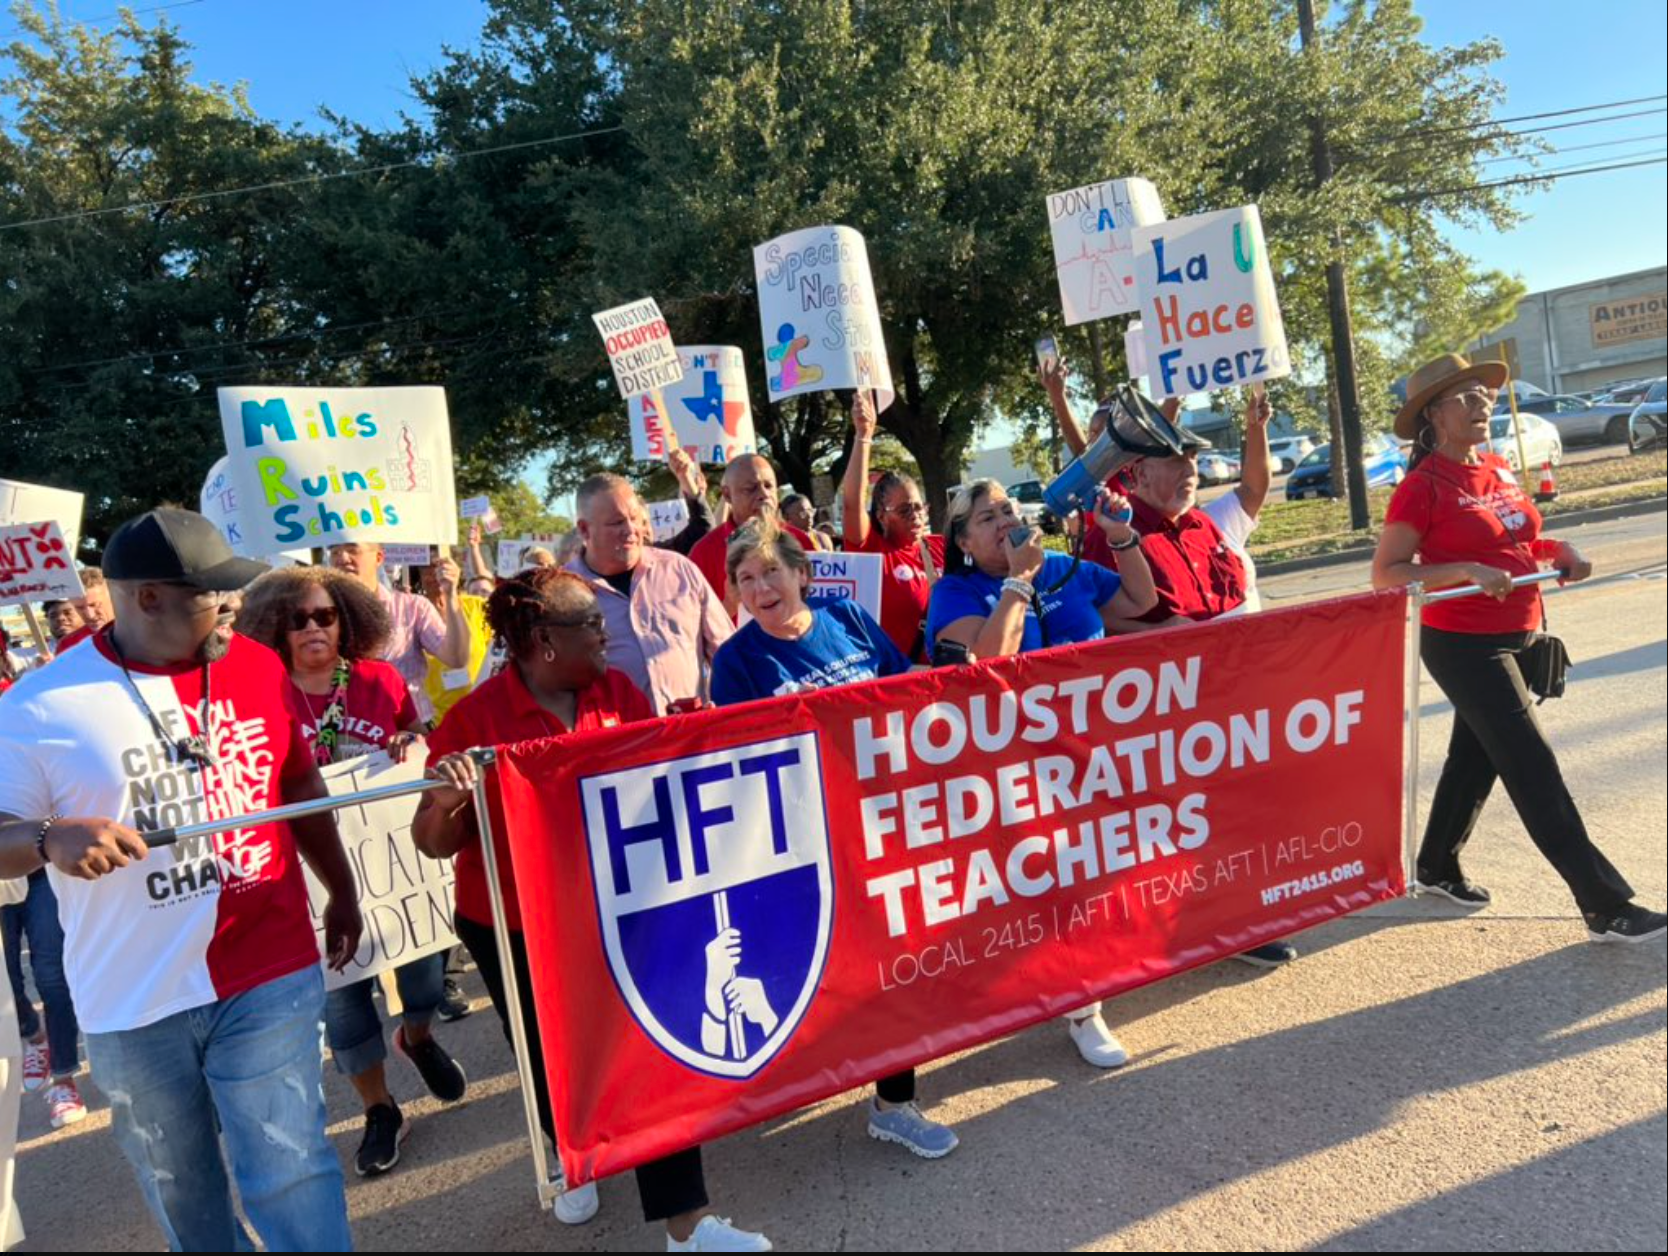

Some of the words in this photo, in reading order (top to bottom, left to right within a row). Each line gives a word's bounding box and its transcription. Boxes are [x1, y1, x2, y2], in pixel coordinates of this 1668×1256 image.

[1053, 184, 1106, 219] DON'T
[1151, 237, 1208, 285] La
[599, 303, 659, 333] HOUSTON
[606, 319, 670, 355] OCCUPIED
[1153, 294, 1254, 345] Hace
[615, 343, 670, 374] SCHOOL
[622, 359, 681, 394] DISTRICT
[241, 398, 377, 447] Miles
[257, 457, 386, 506] Ruins
[275, 496, 398, 544] Schools
[810, 560, 846, 576] TON
[853, 656, 1201, 780] HOUSTON
[860, 709, 1270, 861] FEDERATION
[1285, 690, 1364, 753] OF
[600, 748, 800, 895] HFT
[146, 841, 272, 901] CHANGE
[867, 793, 1210, 939] TEACHERS
[1260, 860, 1364, 906] HFT2415.ORG
[878, 940, 975, 991] LOCAL
[983, 913, 1044, 957] 2415
[1068, 892, 1112, 933] AFT
[1134, 867, 1208, 908] TEXAS
[1214, 849, 1253, 882] AFT
[1276, 821, 1363, 866] AFL-CIO
